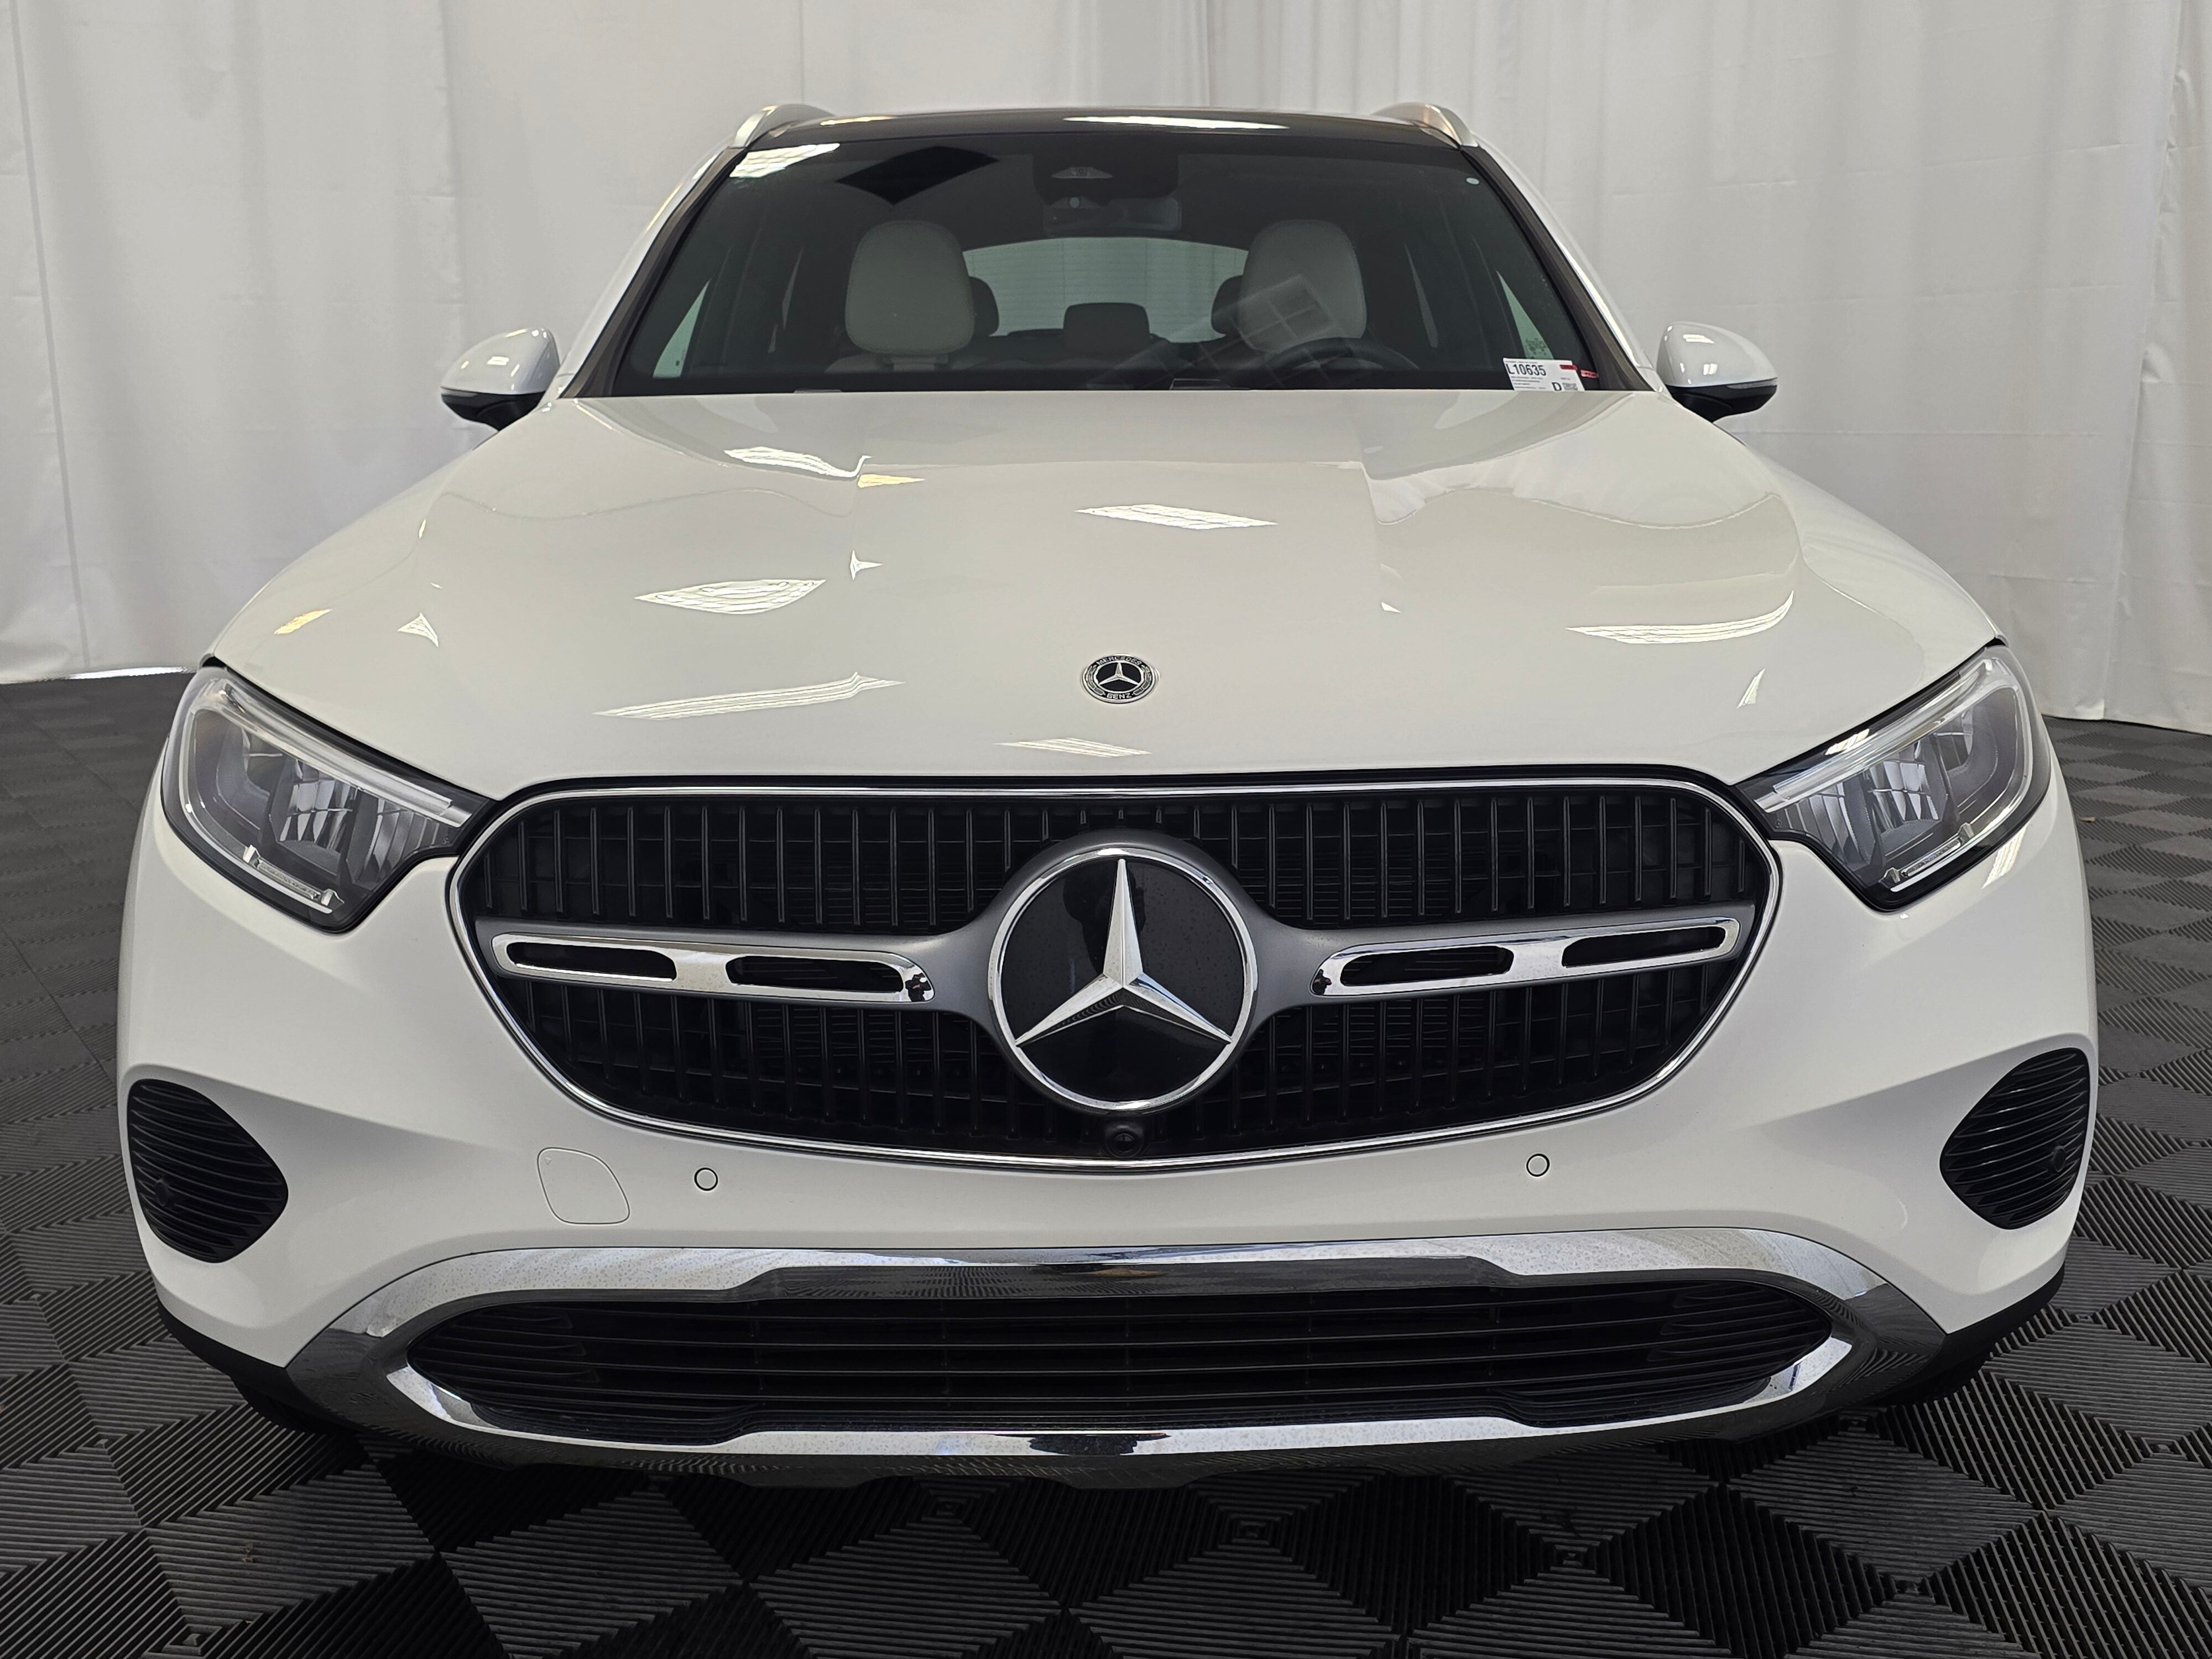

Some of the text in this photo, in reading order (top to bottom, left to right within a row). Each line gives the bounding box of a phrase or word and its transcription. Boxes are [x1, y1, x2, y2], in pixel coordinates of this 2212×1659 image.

[1505, 363, 1546, 376] L10635
[1552, 382, 1562, 391] D
[1096, 656, 1142, 666] MERCEDES
